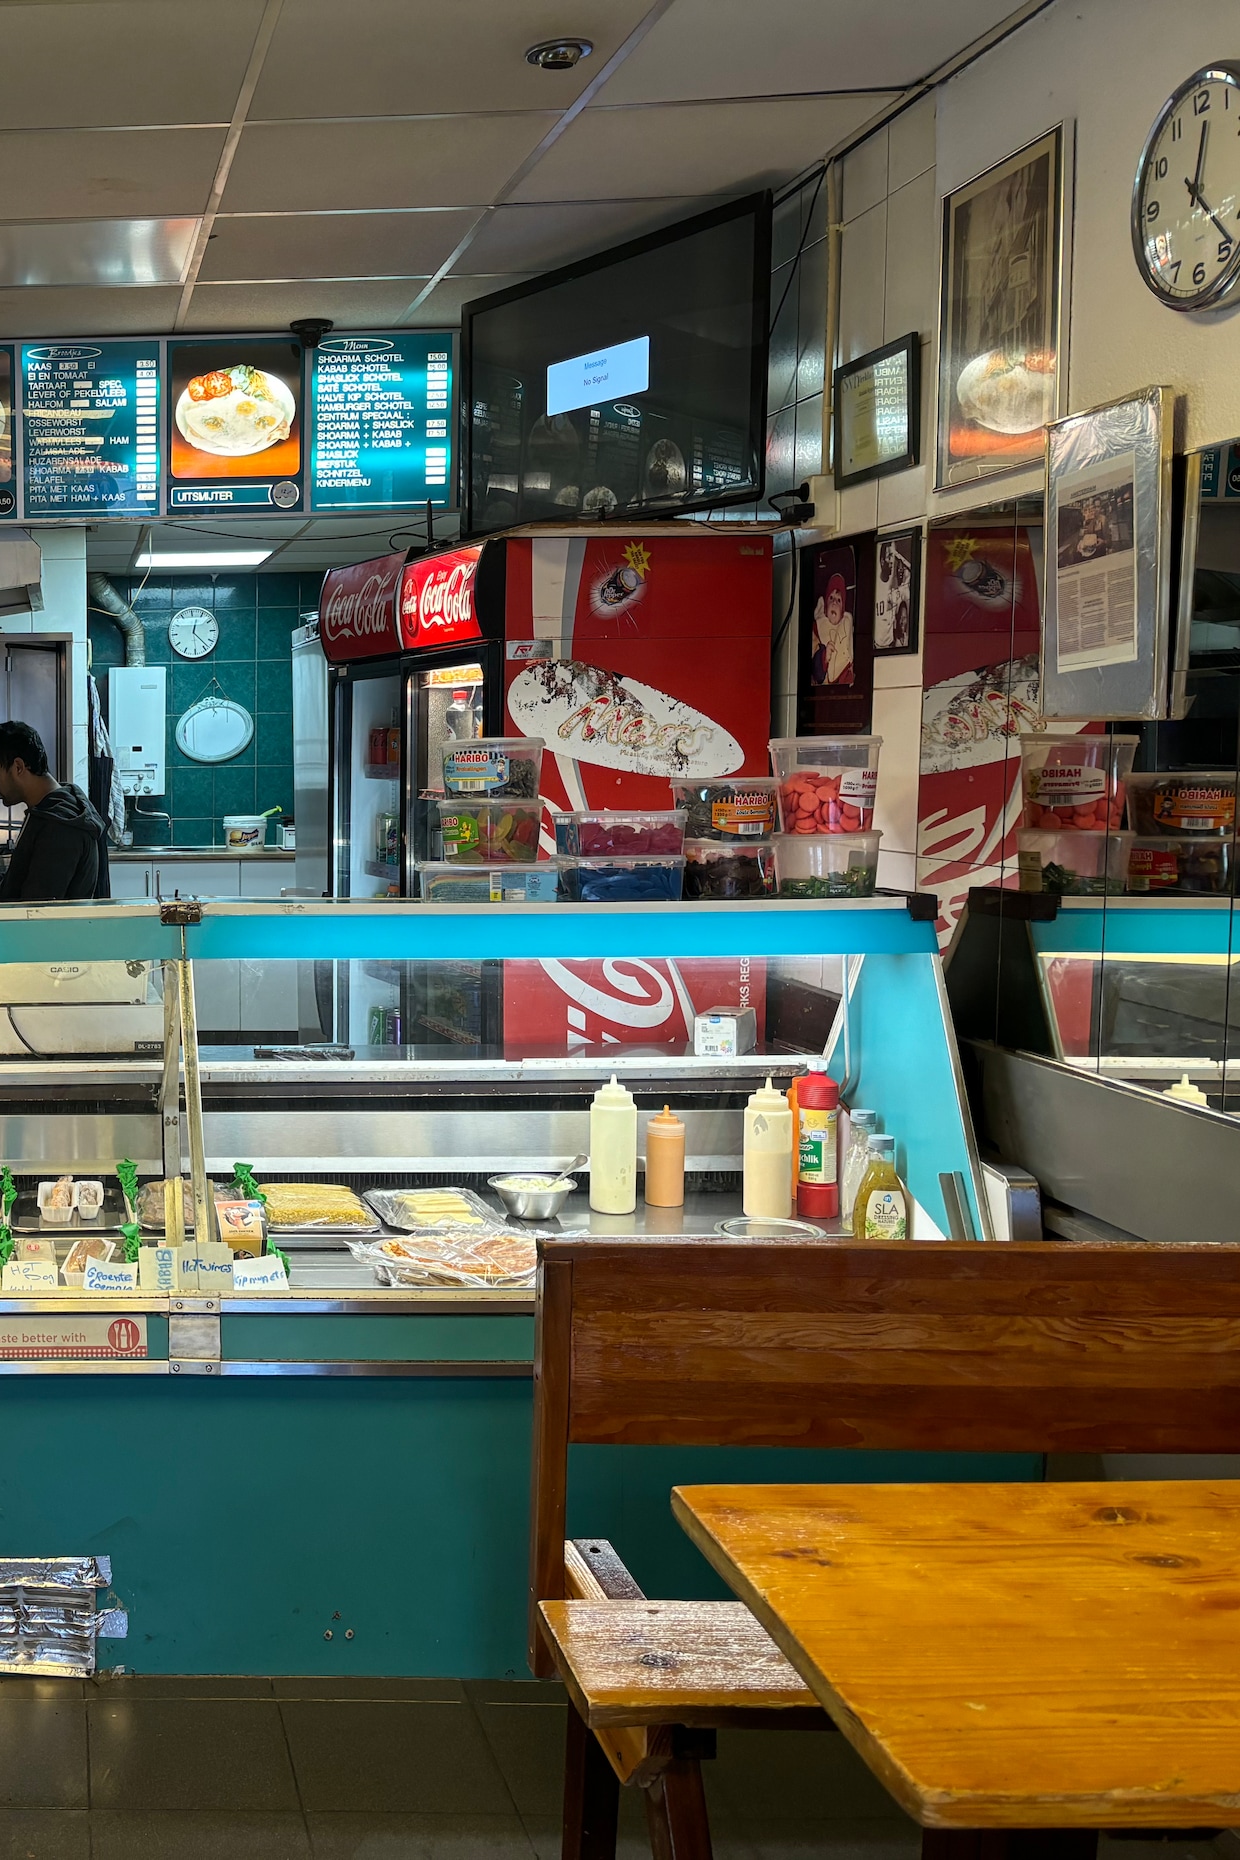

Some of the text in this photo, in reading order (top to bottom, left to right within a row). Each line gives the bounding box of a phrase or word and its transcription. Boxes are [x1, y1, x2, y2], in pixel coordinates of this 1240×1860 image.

[1193, 90, 1210, 115] 12
[1225, 88, 1228, 109] 1
[1172, 118, 1181, 141] 11
[1155, 157, 1168, 180] 10
[1147, 201, 1159, 222] 9
[1217, 242, 1231, 262] 5
[1171, 261, 1182, 283] 7
[1193, 263, 1205, 284] 6
[318, 354, 404, 363] SHOARMA SCHOTEL
[585, 358, 607, 371] Message
[54, 372, 88, 380] TOMAAT
[583, 373, 608, 386] No Signal
[29, 382, 66, 390] TARTAAR
[74, 389, 126, 398] PEKELVLEES
[318, 393, 344, 401] HALVE
[365, 392, 404, 400] SCHOTEL
[318, 402, 414, 411] HAMBURGER SCHOTEL
[316, 479, 371, 487] KINDERMENU
[178, 491, 232, 501] UITSMIJTER
[437, 570, 446, 581] Enjoy
[420, 564, 476, 628] Coca-Cola
[325, 571, 391, 641] Coca-Cola
[455, 754, 488, 763] HARIBO
[735, 796, 767, 806] HARIBO
[441, 818, 458, 826] ARIBO
[875, 1204, 898, 1214] SLA
[21, 1333, 59, 1343] better
[62, 1332, 86, 1343] with
